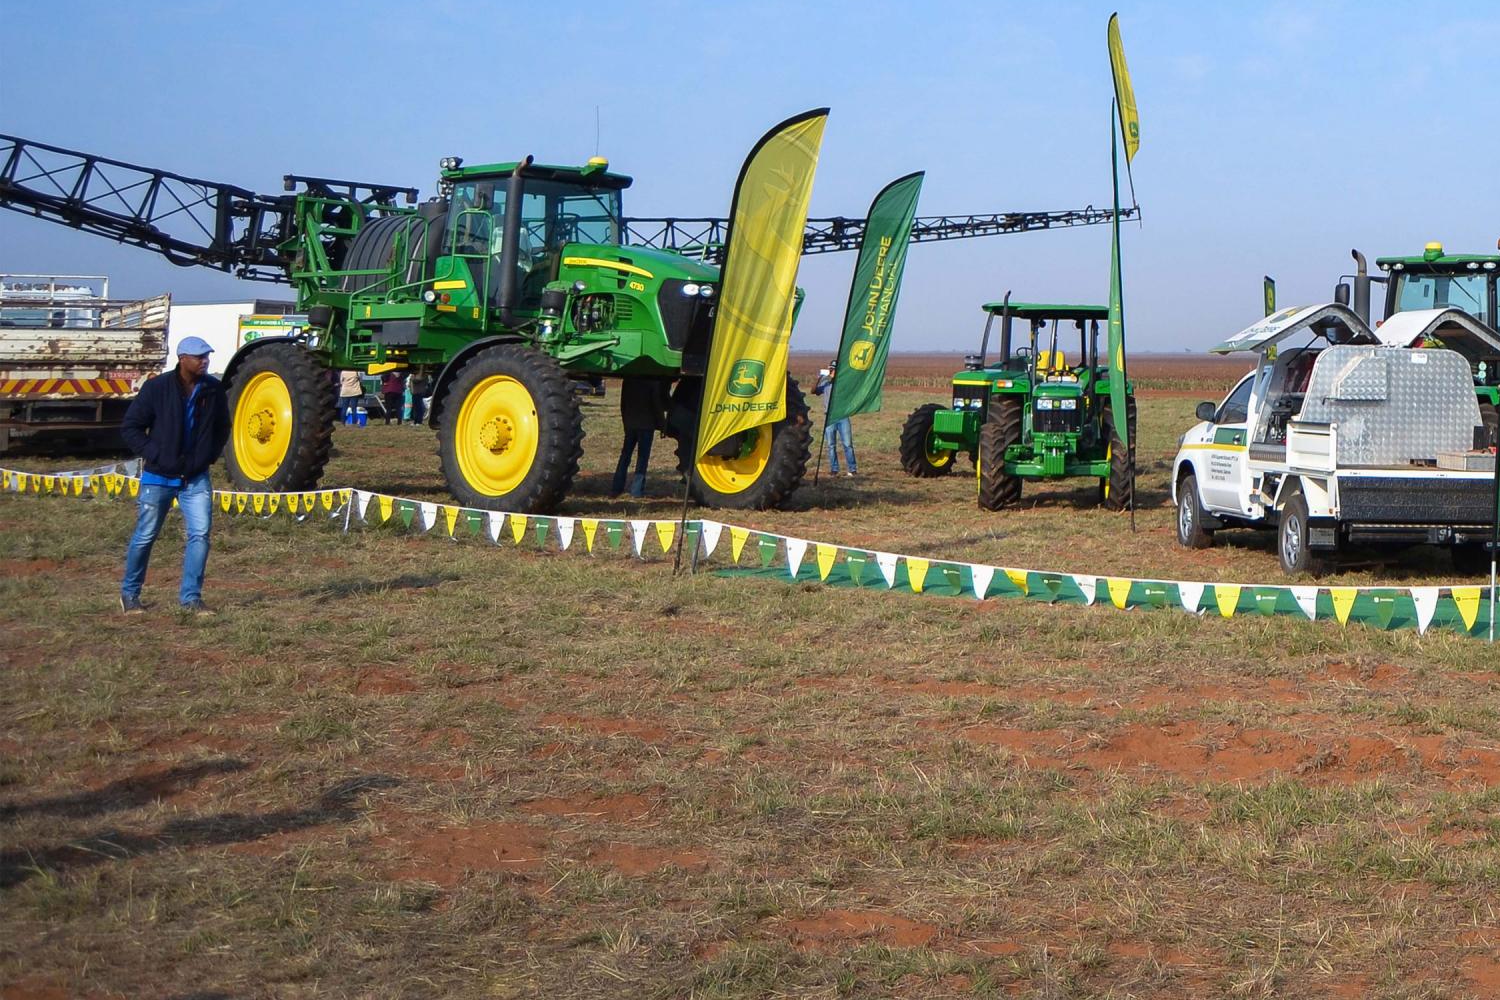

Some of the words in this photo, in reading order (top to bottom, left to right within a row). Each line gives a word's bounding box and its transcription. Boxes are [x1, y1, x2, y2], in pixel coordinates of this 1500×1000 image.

[870, 236, 892, 290] DEERE
[629, 281, 645, 292] 4730
[862, 291, 880, 336] JOHN
[742, 401, 779, 412] DEERE
